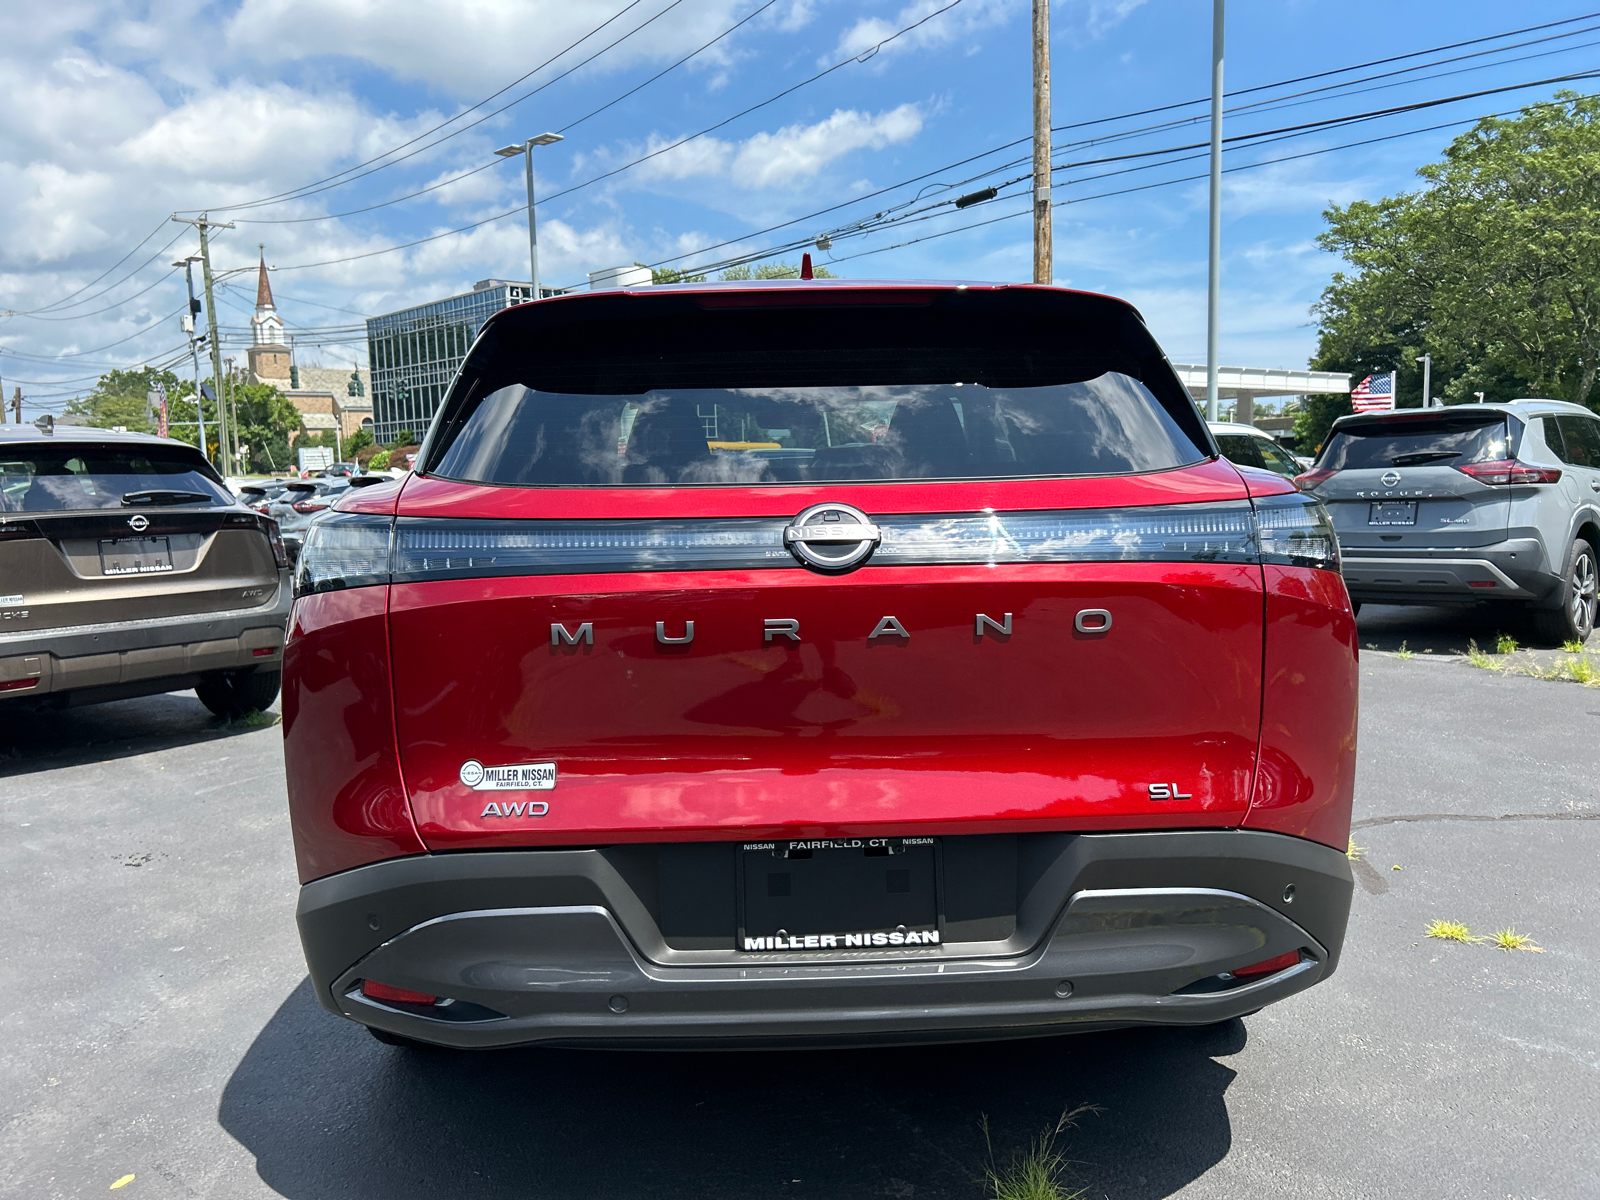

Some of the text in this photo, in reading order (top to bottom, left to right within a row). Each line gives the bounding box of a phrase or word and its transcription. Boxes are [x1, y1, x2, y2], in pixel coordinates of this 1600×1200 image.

[789, 526, 875, 539] NISSAN
[551, 608, 1113, 645] MURANO
[485, 768, 554, 781] MILLER NISSAN
[1148, 783, 1192, 800] SL
[480, 801, 550, 817] AWD
[869, 838, 889, 847] CT
[902, 837, 934, 845] NISSAN
[744, 930, 940, 950] MILLER NISSAN
